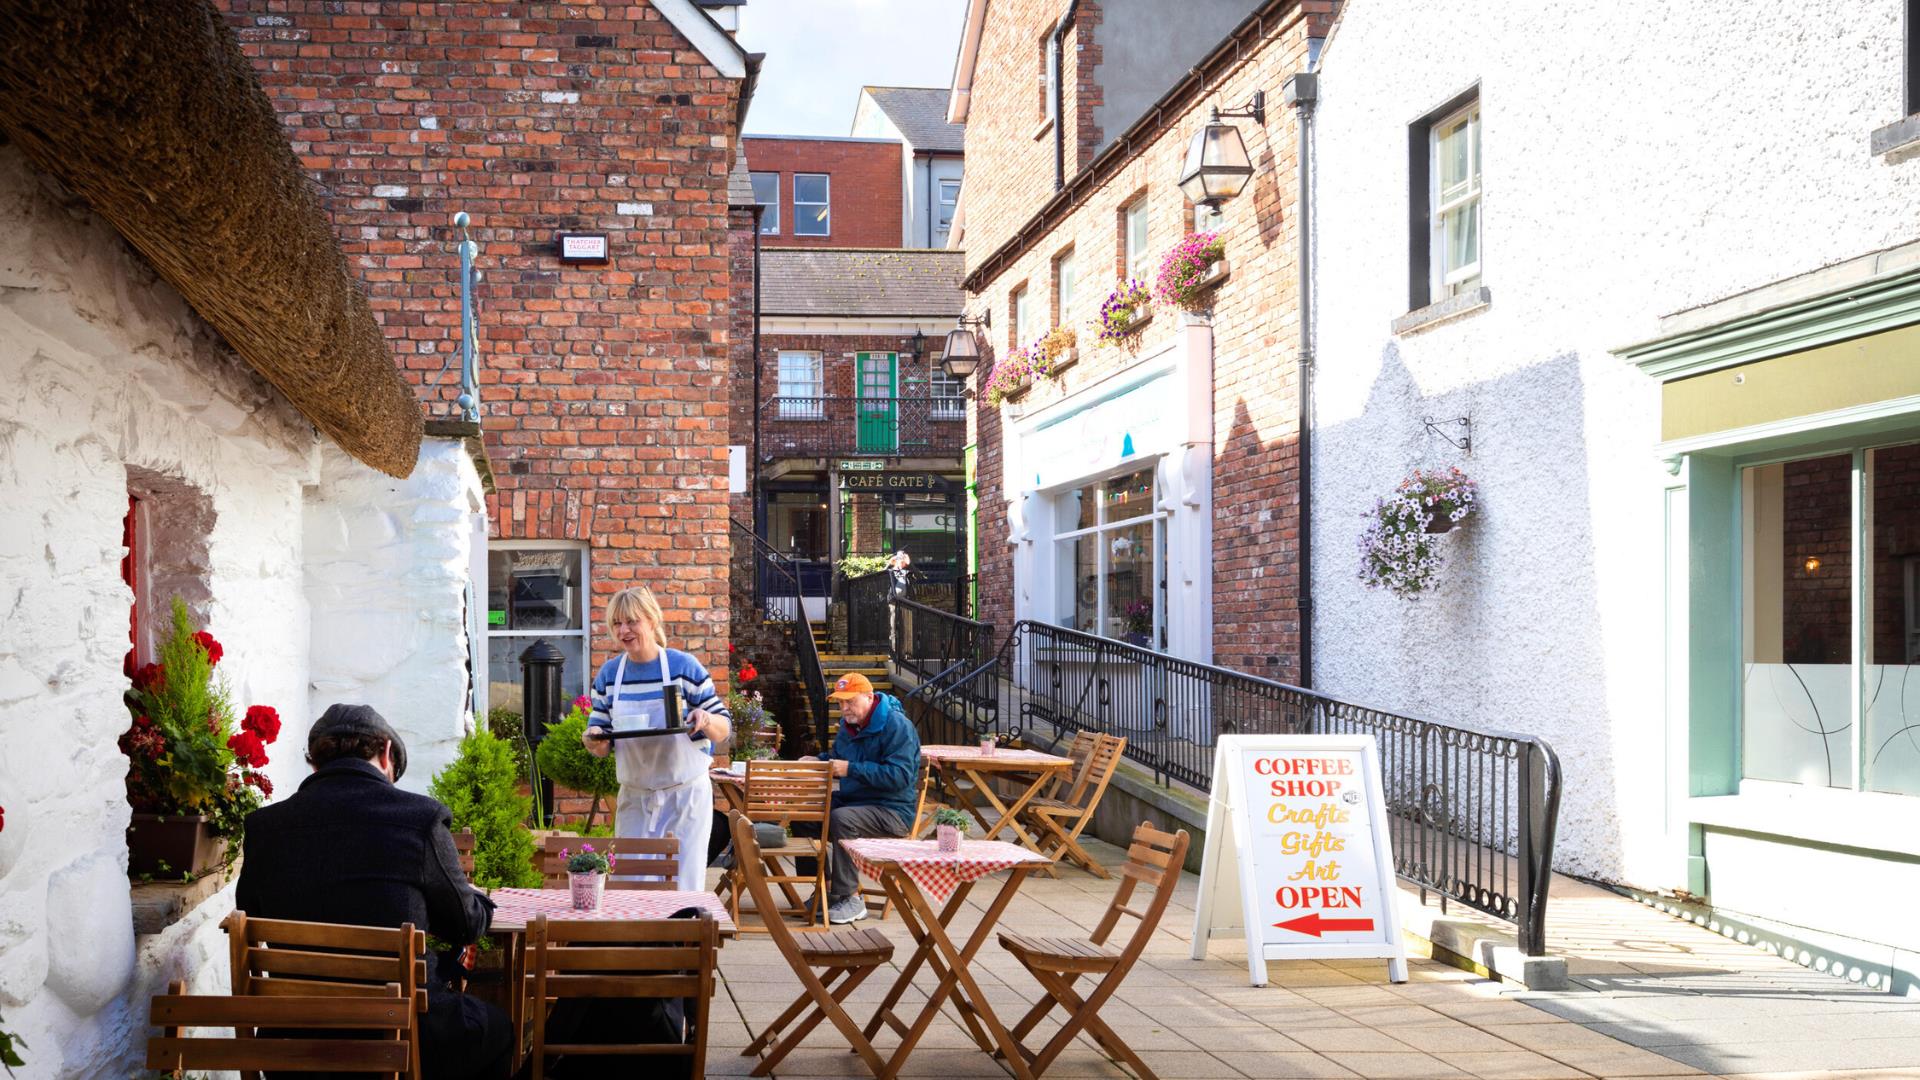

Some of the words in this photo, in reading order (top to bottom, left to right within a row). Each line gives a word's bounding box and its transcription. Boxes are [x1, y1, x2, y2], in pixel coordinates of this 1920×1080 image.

[849, 474, 884, 487] CAFÉ
[889, 476, 924, 487] GATE
[1254, 758, 1354, 776] COFFEE
[1271, 779, 1342, 797] SHOP
[1267, 802, 1350, 830] Crafts
[1281, 830, 1345, 858] Gifts
[1287, 860, 1342, 881] Art
[1275, 886, 1363, 909] OPEN
